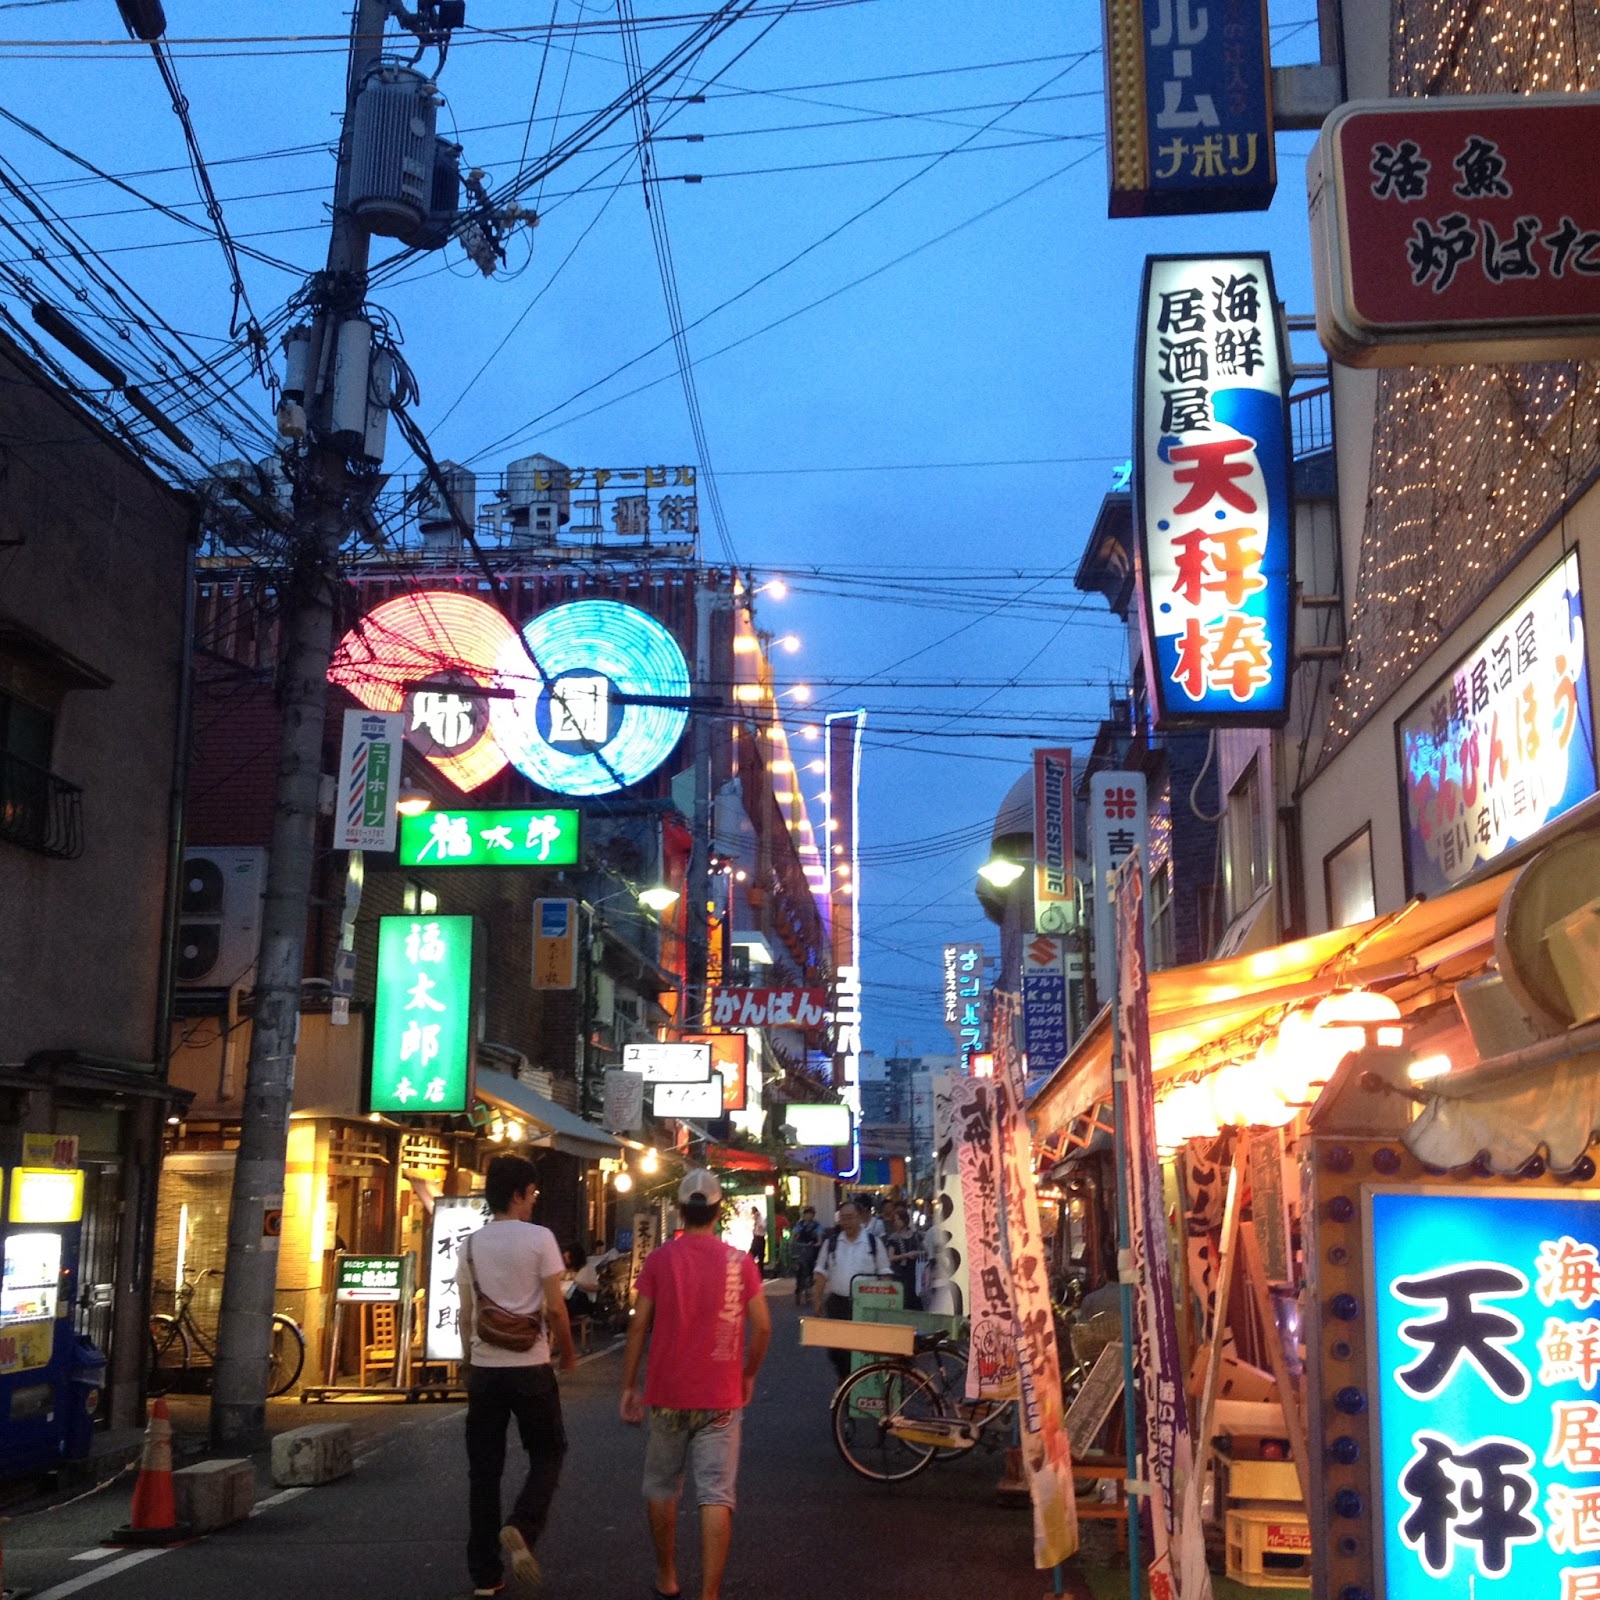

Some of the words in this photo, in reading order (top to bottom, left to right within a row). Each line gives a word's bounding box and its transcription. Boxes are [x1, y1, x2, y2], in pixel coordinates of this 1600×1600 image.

[1155, 132, 1259, 179] ナポリ
[1370, 138, 1511, 200] 活魚
[1211, 273, 1265, 377] 海鮮
[1156, 287, 1212, 434] 居酒屋
[534, 466, 695, 491] レジャービル
[1169, 438, 1271, 698] 天秤棒
[367, 743, 386, 826] ニューホープ
[1044, 756, 1066, 896] BRIDGESTONE
[400, 922, 446, 1067] 福太郎
[714, 988, 822, 1025] かんばん
[1027, 977, 1062, 987] アルト
[1027, 990, 1062, 1001] Kei
[1028, 1003, 1062, 1014] ワゴンR
[1029, 1029, 1063, 1039] エスクード
[392, 1076, 447, 1104] 本店
[1395, 1267, 1539, 1573] 天秤
